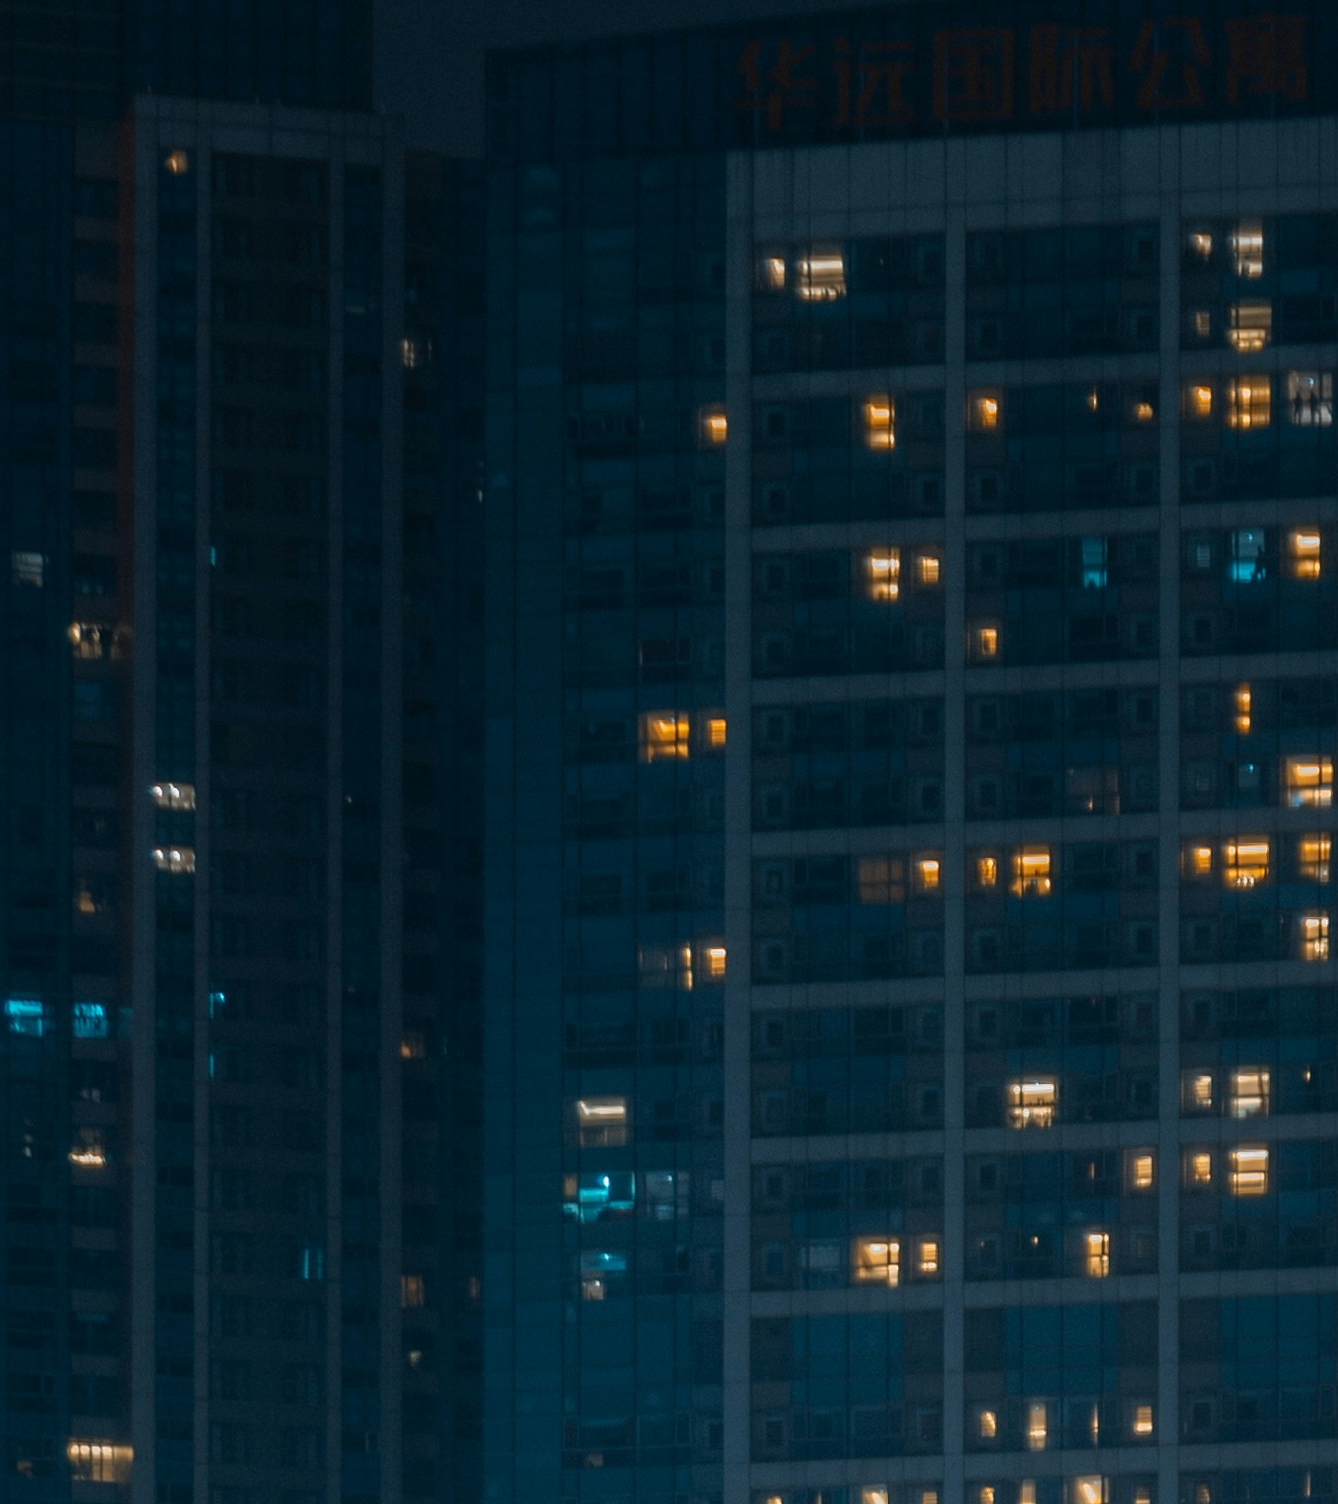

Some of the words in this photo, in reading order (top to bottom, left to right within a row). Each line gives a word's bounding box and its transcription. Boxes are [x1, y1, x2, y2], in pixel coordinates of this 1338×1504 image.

[732, 12, 1309, 131] 华远国际公寓
